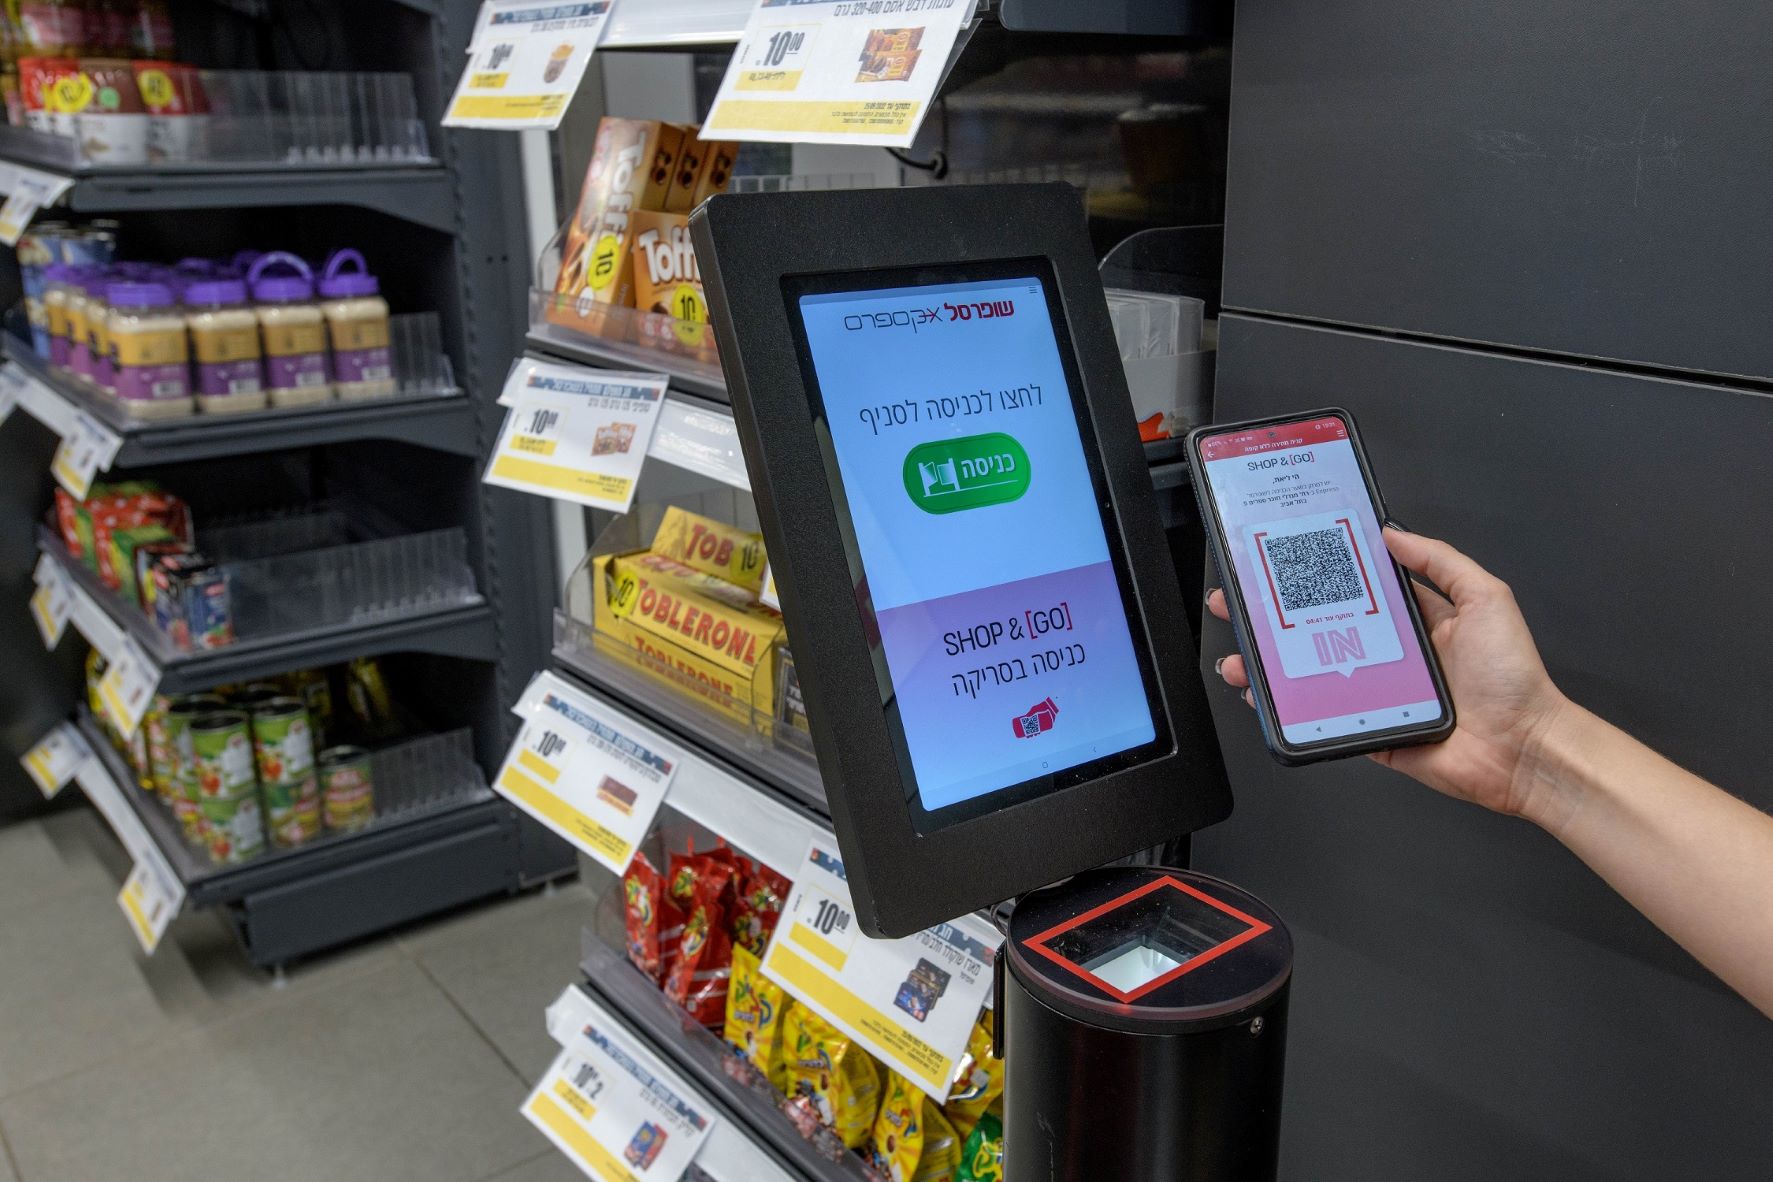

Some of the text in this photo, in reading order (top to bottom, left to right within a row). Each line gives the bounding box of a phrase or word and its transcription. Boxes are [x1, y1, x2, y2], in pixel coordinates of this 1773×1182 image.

[850, 3, 881, 16] 320-400
[943, 300, 1015, 322] שופרסל
[859, 383, 1044, 436] לחצו לכניסה לסניף
[961, 452, 1017, 479] כניסה
[1247, 451, 1315, 472] SHOP & [GO]
[942, 602, 1073, 656] SHOP & [GO]
[1312, 626, 1366, 666] IN
[951, 643, 1087, 699] כניסה בסריקה
